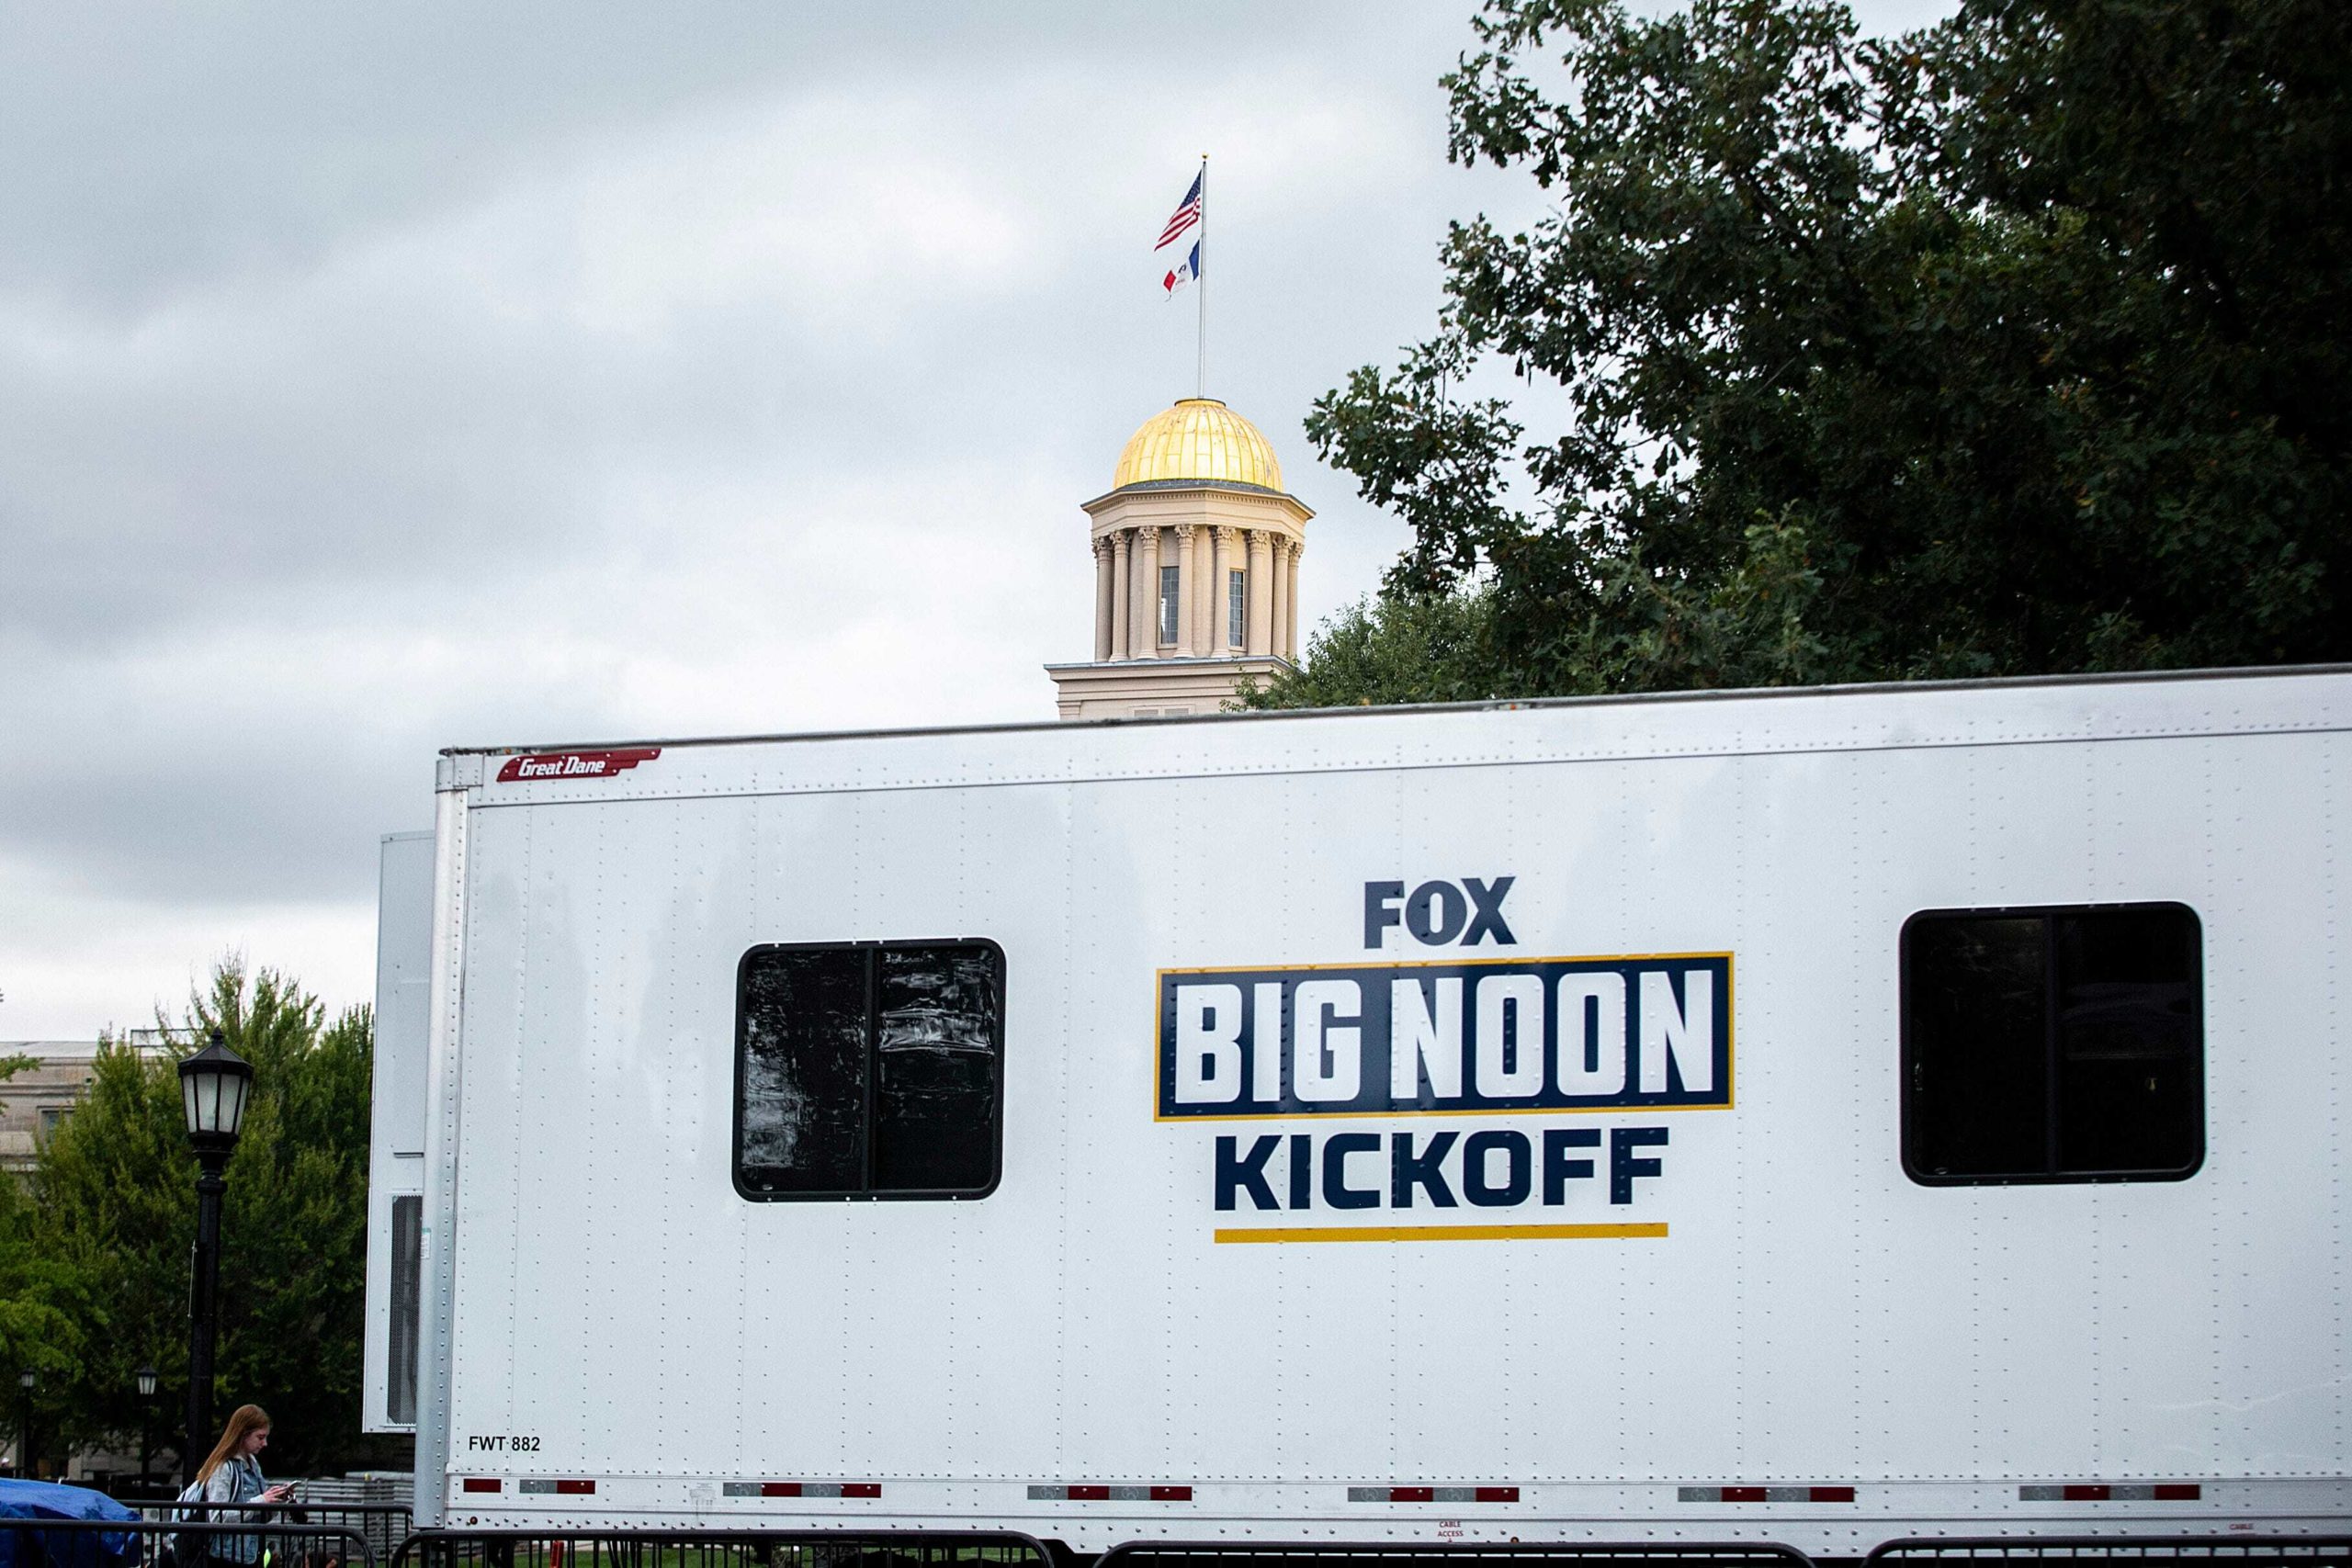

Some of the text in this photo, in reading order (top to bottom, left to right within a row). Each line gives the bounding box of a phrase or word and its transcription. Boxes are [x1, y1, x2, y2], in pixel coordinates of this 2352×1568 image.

[518, 757, 605, 776] Great Dane
[1364, 876, 1517, 949] FOX
[1175, 970, 1713, 1103] BIG NOON
[1215, 1127, 1668, 1211] KICKOFF
[469, 1436, 540, 1451] FWT 882
